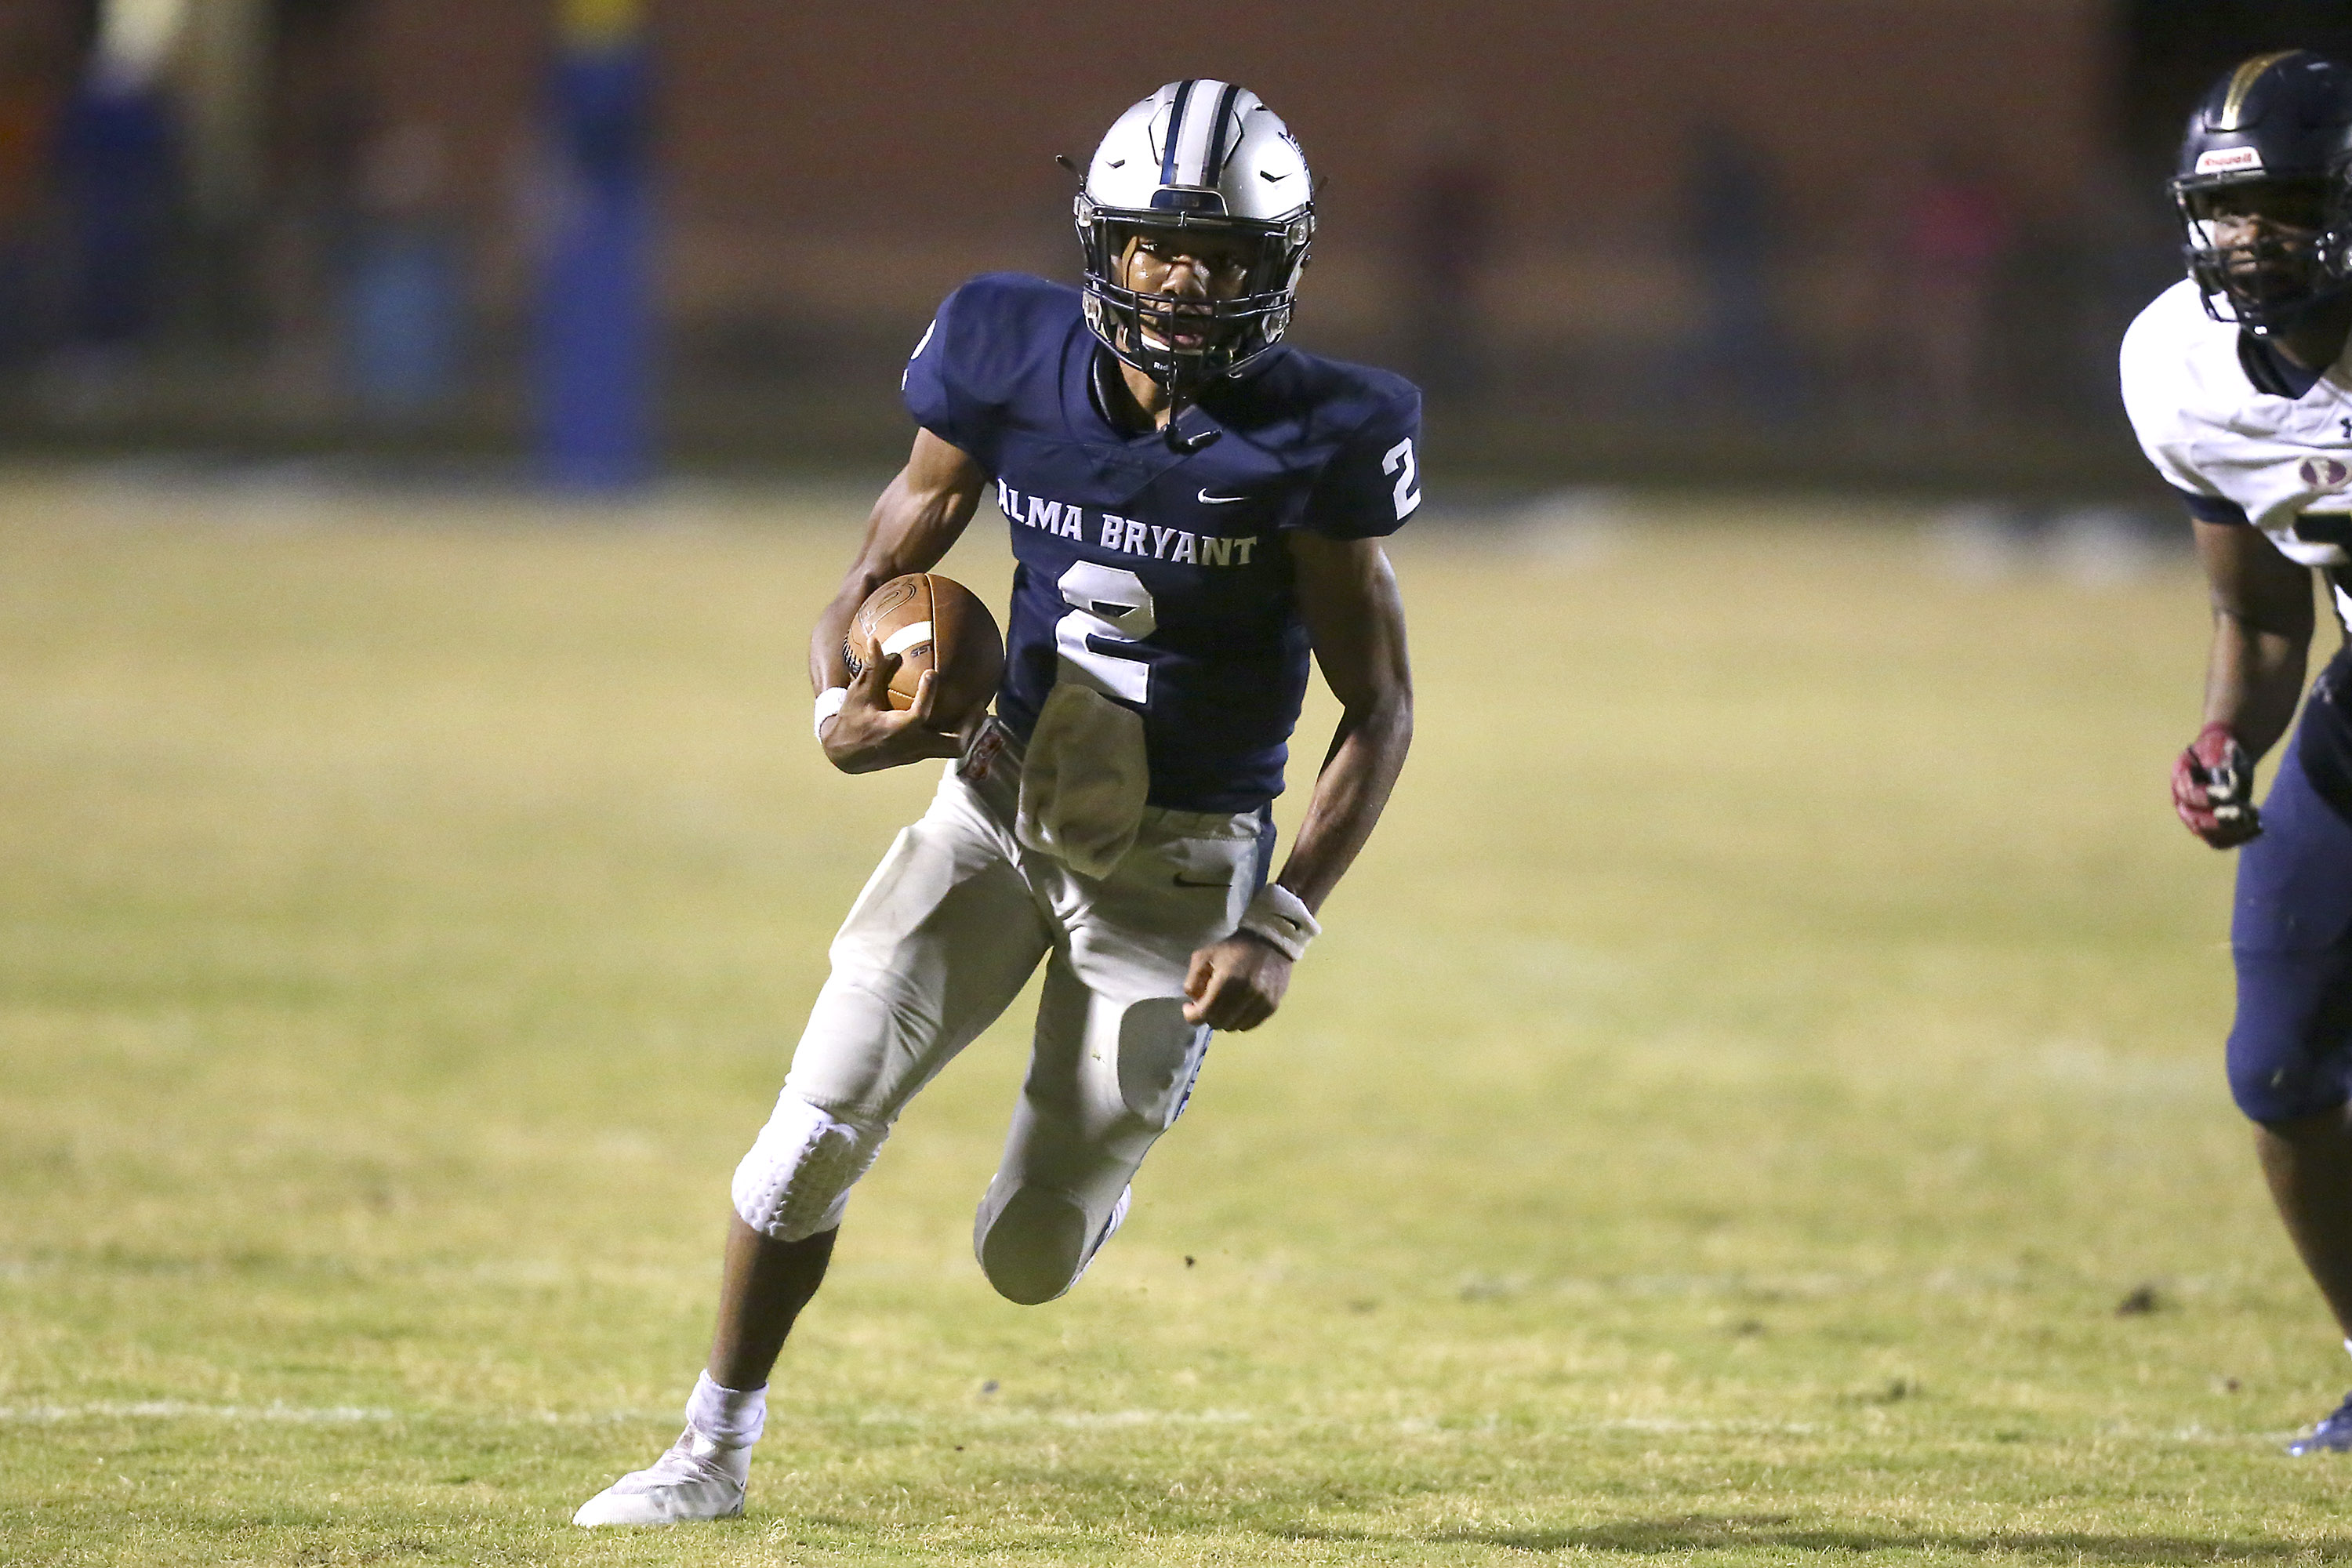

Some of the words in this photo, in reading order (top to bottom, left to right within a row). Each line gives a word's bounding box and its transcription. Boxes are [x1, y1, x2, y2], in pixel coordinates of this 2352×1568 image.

[998, 477, 1083, 541] ALMA
[1100, 514, 1258, 566] BRYANT
[1382, 437, 1421, 520] 2
[1055, 559, 1157, 704] 2
